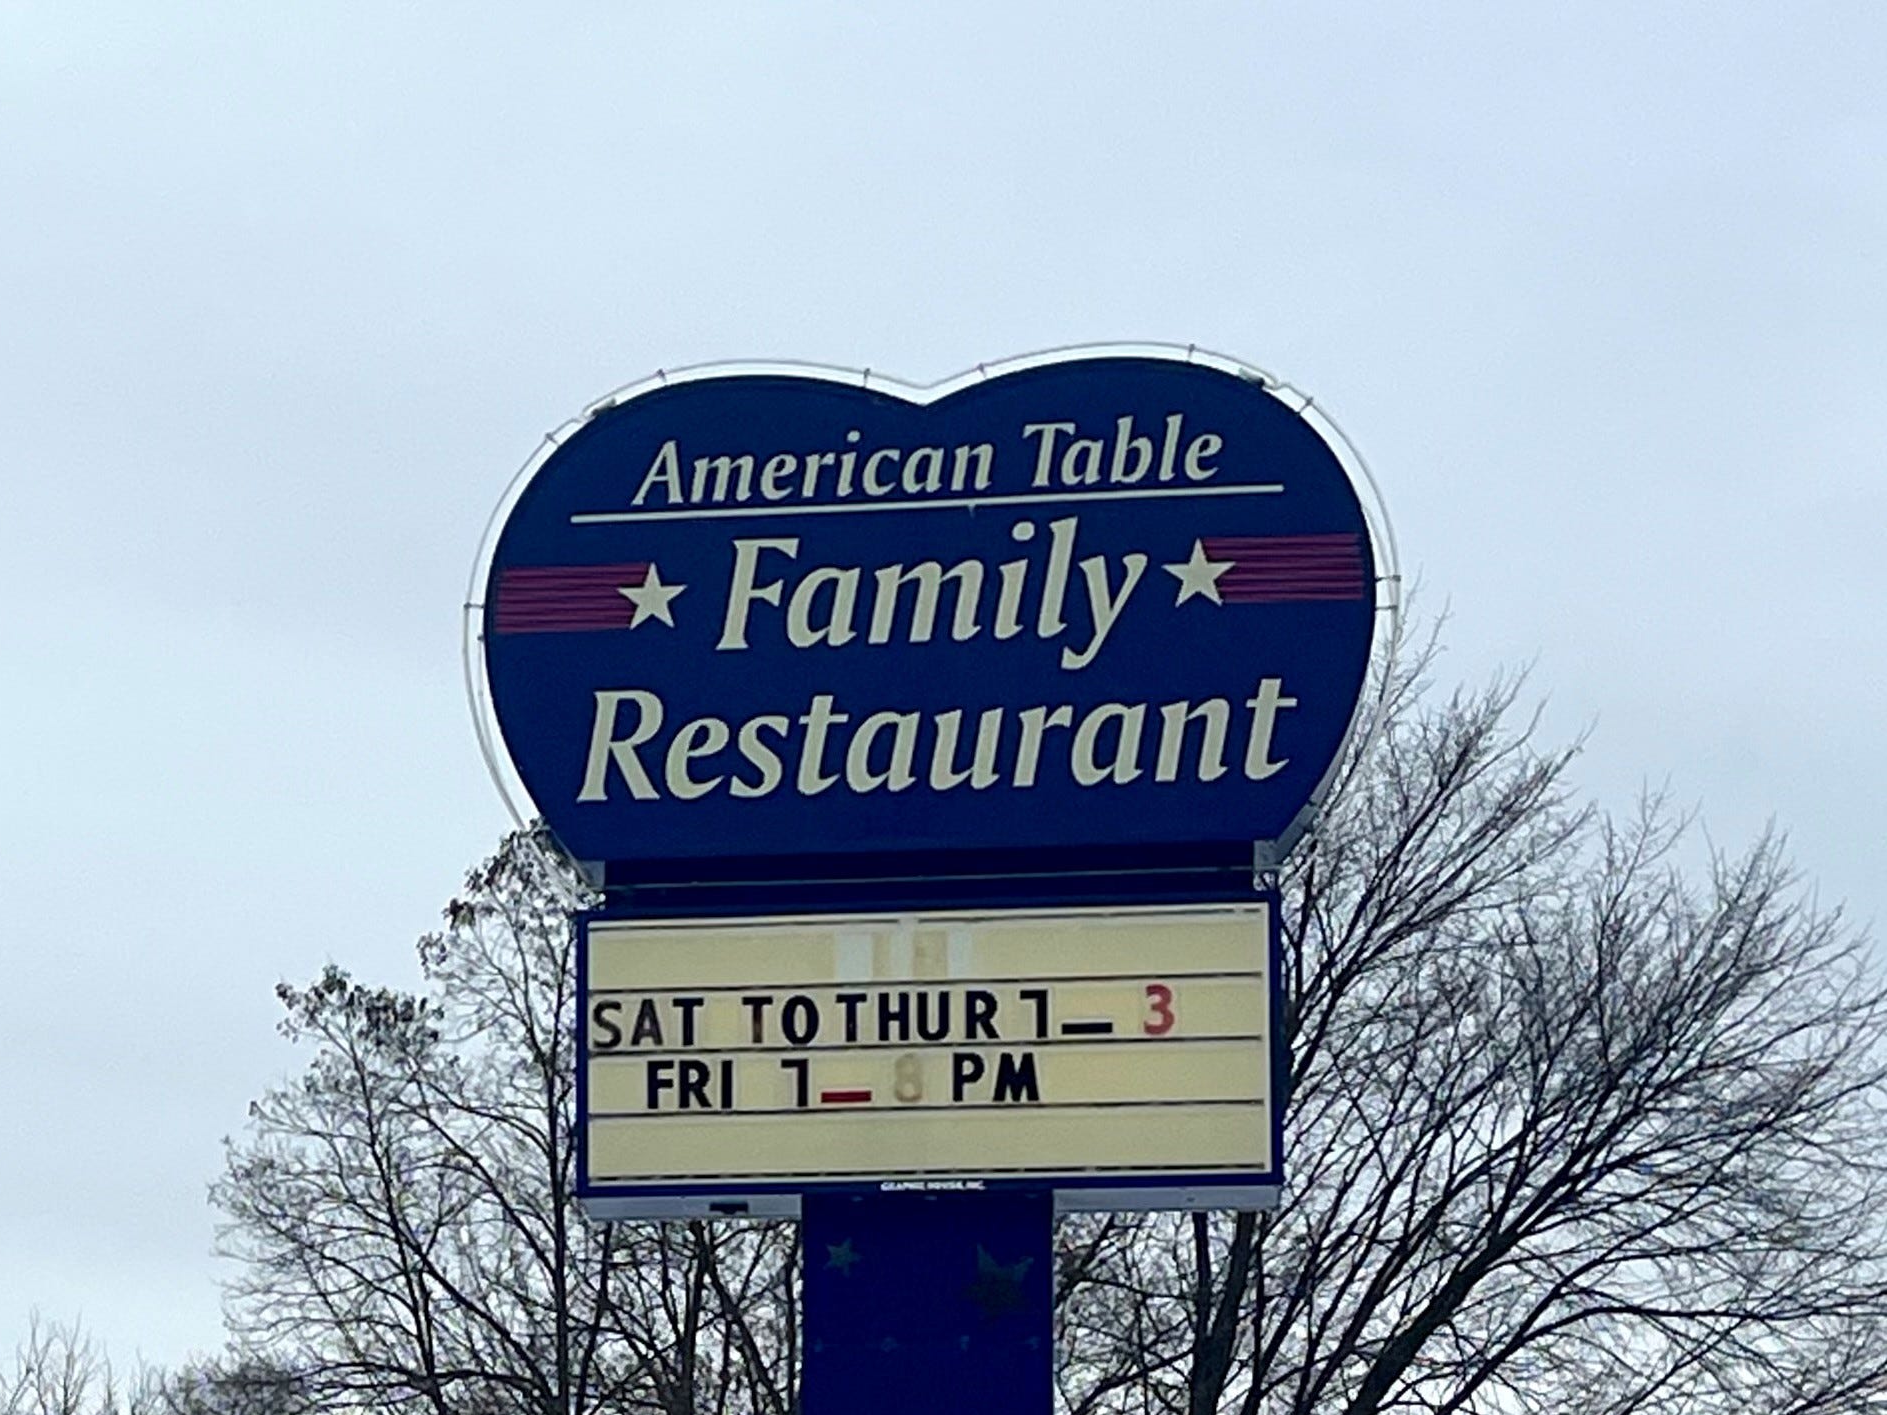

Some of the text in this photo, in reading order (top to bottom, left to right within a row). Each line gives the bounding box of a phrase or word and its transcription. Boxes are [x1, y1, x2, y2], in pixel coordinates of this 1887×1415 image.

[632, 415, 1221, 503] American Table
[716, 517, 1147, 669] Family
[577, 679, 1297, 801] Restaurant
[592, 997, 704, 1048] SAT
[646, 1060, 733, 1110] FRI
[952, 1052, 1040, 1103] PM
